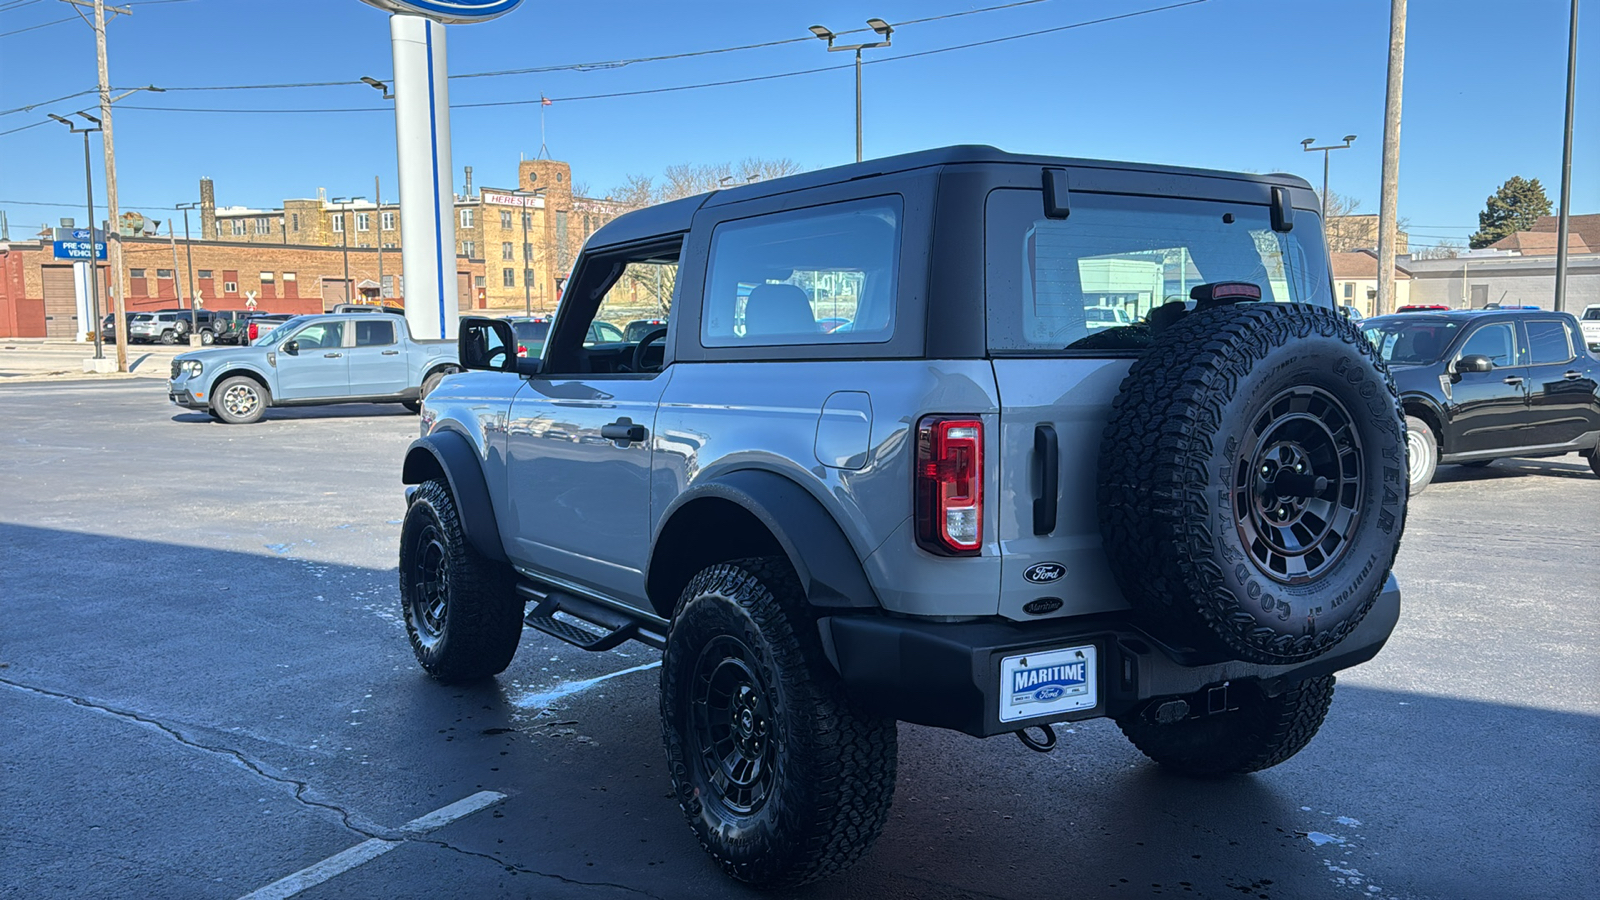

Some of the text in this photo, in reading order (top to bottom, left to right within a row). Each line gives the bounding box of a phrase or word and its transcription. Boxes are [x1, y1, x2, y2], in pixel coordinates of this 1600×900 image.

[491, 195, 536, 206] HERESTE
[63, 242, 103, 250] PRE-OWED
[1032, 566, 1060, 580] Ford
[1331, 553, 1378, 610] TERRITORY
[1028, 600, 1060, 612] Maritime
[1015, 663, 1085, 692] MARITIME
[1039, 688, 1060, 699] Ford
